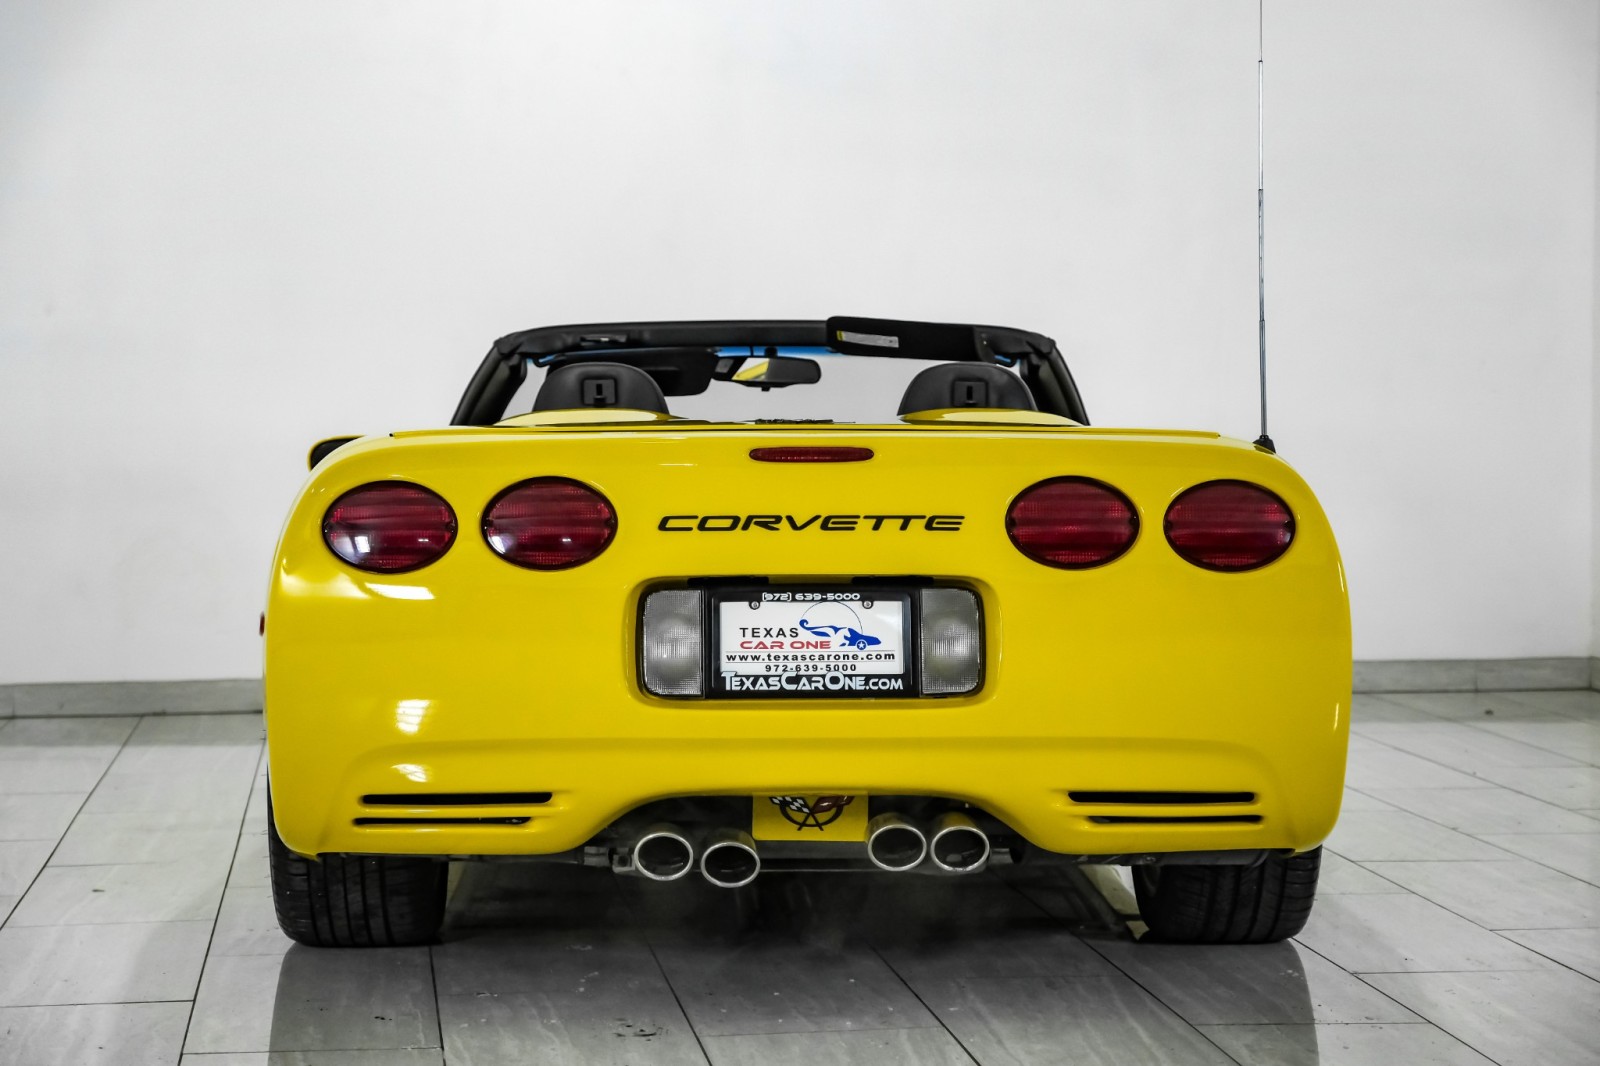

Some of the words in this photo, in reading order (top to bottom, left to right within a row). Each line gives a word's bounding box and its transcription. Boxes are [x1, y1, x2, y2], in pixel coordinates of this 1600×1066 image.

[657, 514, 965, 532] CORVETTE
[795, 593, 861, 601] 639-5000
[739, 627, 799, 638] TEXAS
[740, 640, 785, 650] CAR
[790, 640, 832, 650] ONE
[726, 652, 896, 662] www.texascarone.com
[765, 664, 857, 673] 972-639-5000
